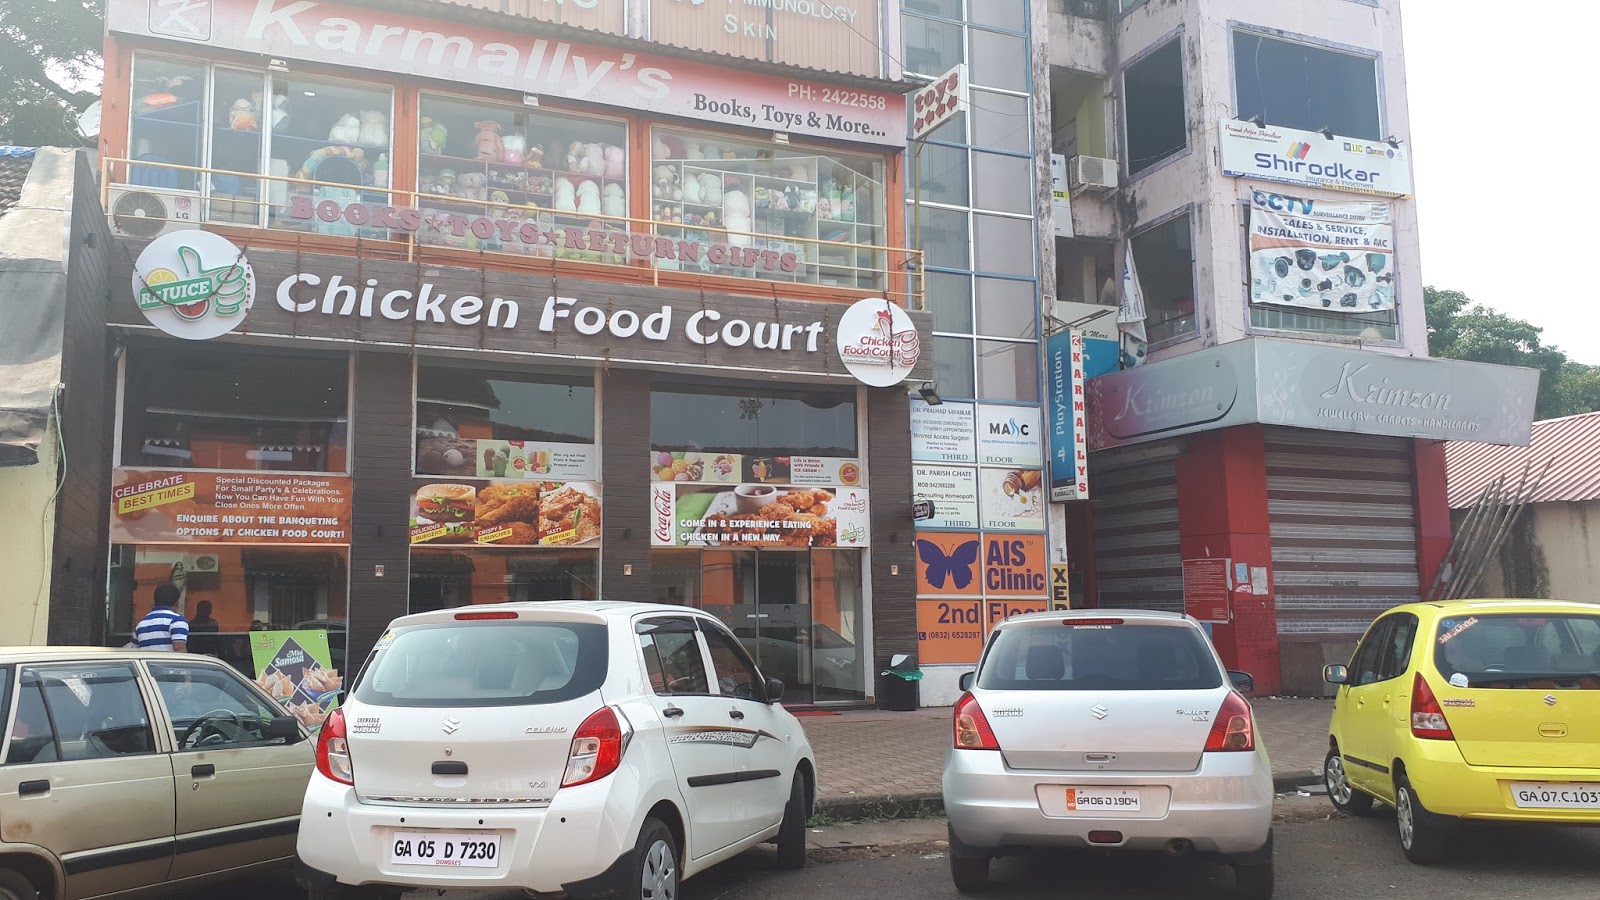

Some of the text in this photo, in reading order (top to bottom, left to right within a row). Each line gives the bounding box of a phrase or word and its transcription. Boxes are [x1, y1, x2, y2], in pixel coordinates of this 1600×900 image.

[724, 13, 778, 40] SKIN
[246, 0, 673, 98] Karmally's
[788, 83, 886, 111] PH: 2422558
[914, 72, 959, 113] toys
[694, 93, 886, 137] Books, Toys & More...
[1352, 144, 1363, 153] LIC
[1254, 152, 1380, 183] Shirodkar
[1305, 175, 1334, 184] Insurance
[1253, 190, 1314, 215] CCTV
[175, 211, 189, 220] LG
[1313, 211, 1348, 220] SURVEILLANCE
[1283, 218, 1367, 236] SALES & SERVICE,
[290, 196, 798, 272] BOOKS TOYS RETURN GIFTS
[1335, 235, 1359, 246] RENT
[1363, 238, 1371, 246] &
[140, 281, 210, 305] REJUICE
[276, 273, 824, 353] Chicken Food Court
[1089, 330, 1109, 339] More
[860, 336, 901, 347] Chicken
[844, 345, 900, 357] Food Court
[1320, 361, 1451, 411] Krimzon
[1054, 350, 1066, 435] PlayStation
[941, 453, 969, 461] THIRD
[115, 474, 184, 499] CELEBRATE
[216, 476, 330, 488] Special Discounted Packages
[231, 485, 254, 493] Small
[255, 486, 282, 495] Party's
[284, 486, 290, 494] &
[292, 487, 342, 496] Celebrations.
[123, 485, 191, 509] BEST TIMES
[235, 493, 250, 501] You
[269, 494, 289, 502] Have
[307, 495, 325, 503] With
[327, 496, 344, 504] Your
[215, 501, 238, 509] Close
[262, 502, 281, 510] More
[283, 503, 306, 511] Often.
[176, 514, 338, 526] ENQUIRE ABOUT THE BANQUETING
[680, 519, 812, 529] COME IN & EXPERIENCE EATING
[989, 520, 1016, 528] FLOOR
[175, 527, 345, 539] OPTIONS AT CHICKEN FOOD COURT!
[411, 523, 441, 536] DELICIOUS
[415, 529, 443, 541] BURGERS
[478, 526, 497, 536] CRISPY
[480, 529, 511, 542] CRUNCHIES
[545, 526, 562, 535] TASTY
[549, 532, 571, 542] BIRYANI
[680, 533, 784, 543] CHICKEN IN A NEW WAY..
[986, 540, 1026, 567] AIS
[986, 568, 1045, 591] Clinic
[937, 602, 1046, 624] 2nd Flo
[1451, 616, 1479, 637] SERVICE
[928, 631, 981, 640] (0832) 6528287
[286, 649, 304, 658] Mini
[275, 655, 305, 667] Samosa
[1519, 790, 1600, 803] GA.07.C.103
[394, 839, 496, 860] GA 05 D 7230
